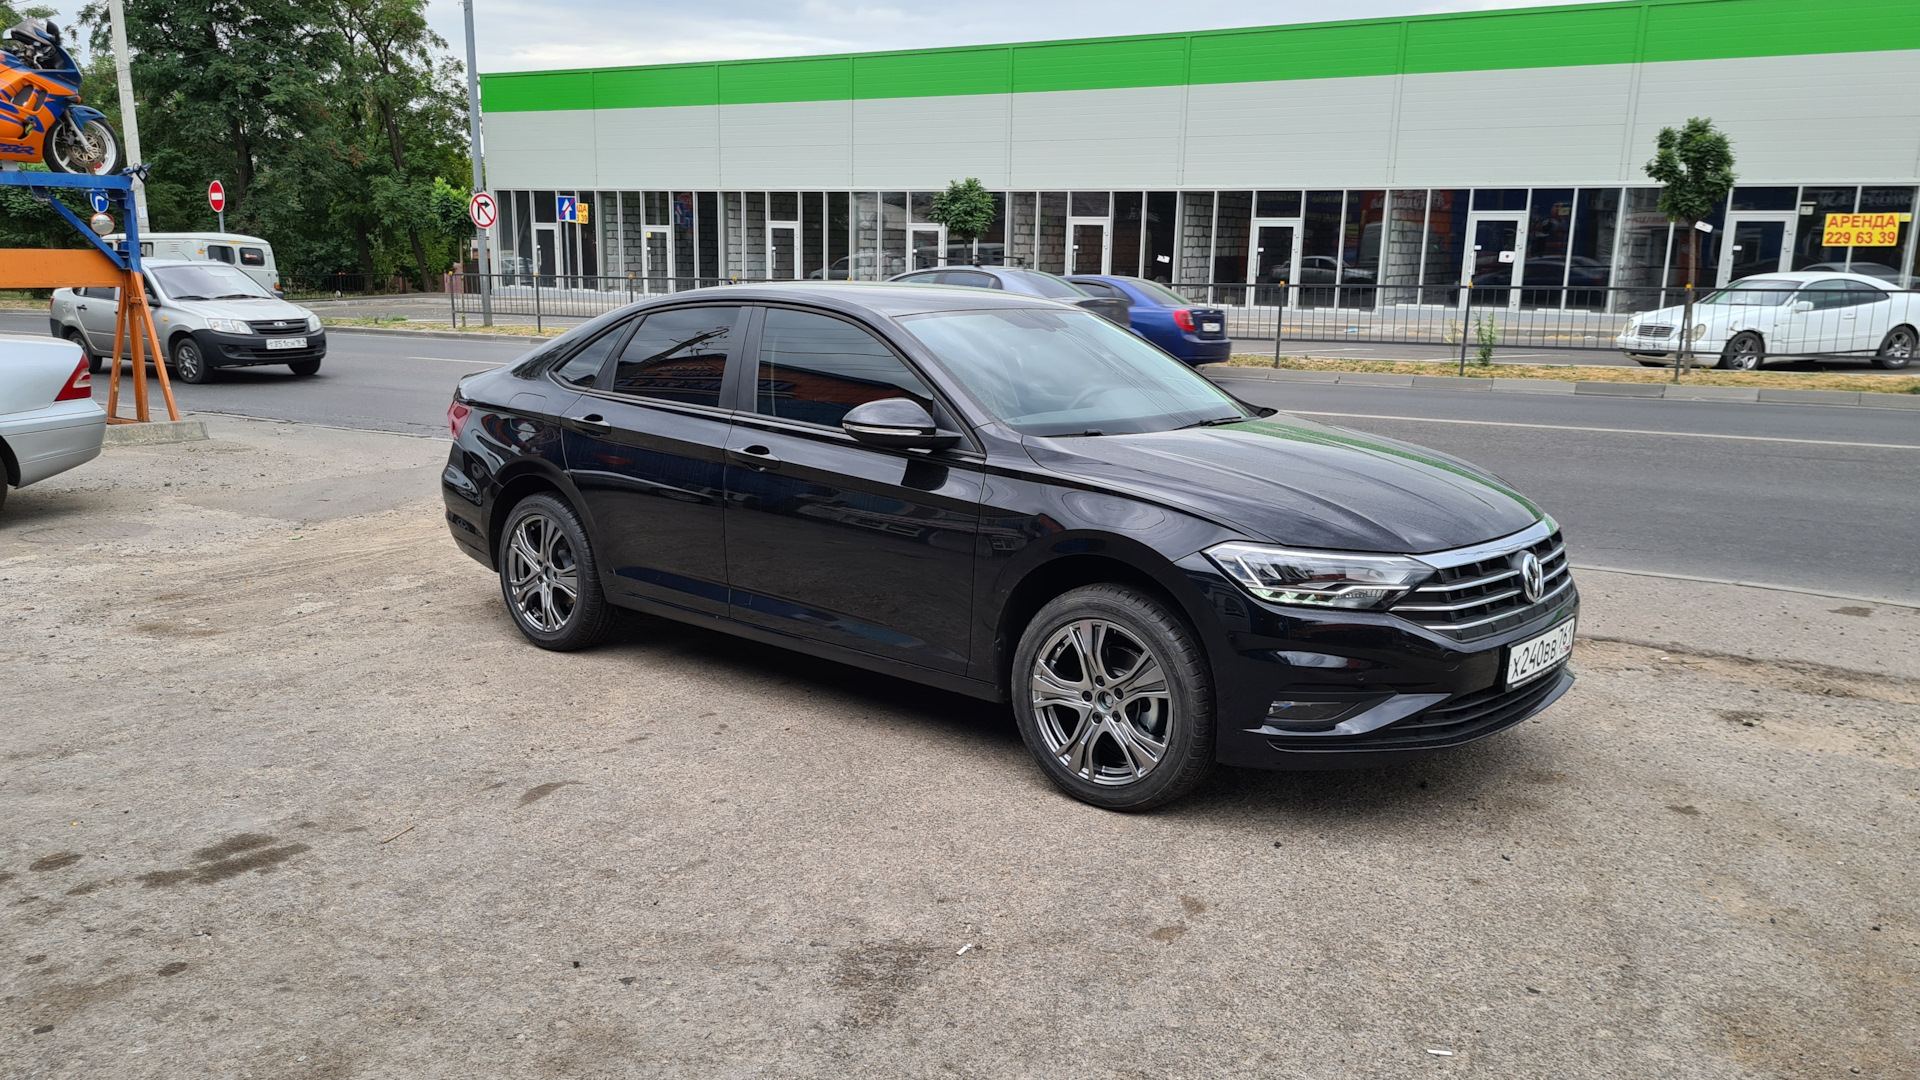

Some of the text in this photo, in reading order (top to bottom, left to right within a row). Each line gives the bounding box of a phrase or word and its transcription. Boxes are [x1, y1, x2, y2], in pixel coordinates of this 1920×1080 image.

[1827, 215, 1897, 230] АРЕНДА
[1825, 231, 1896, 244] 229 63 39
